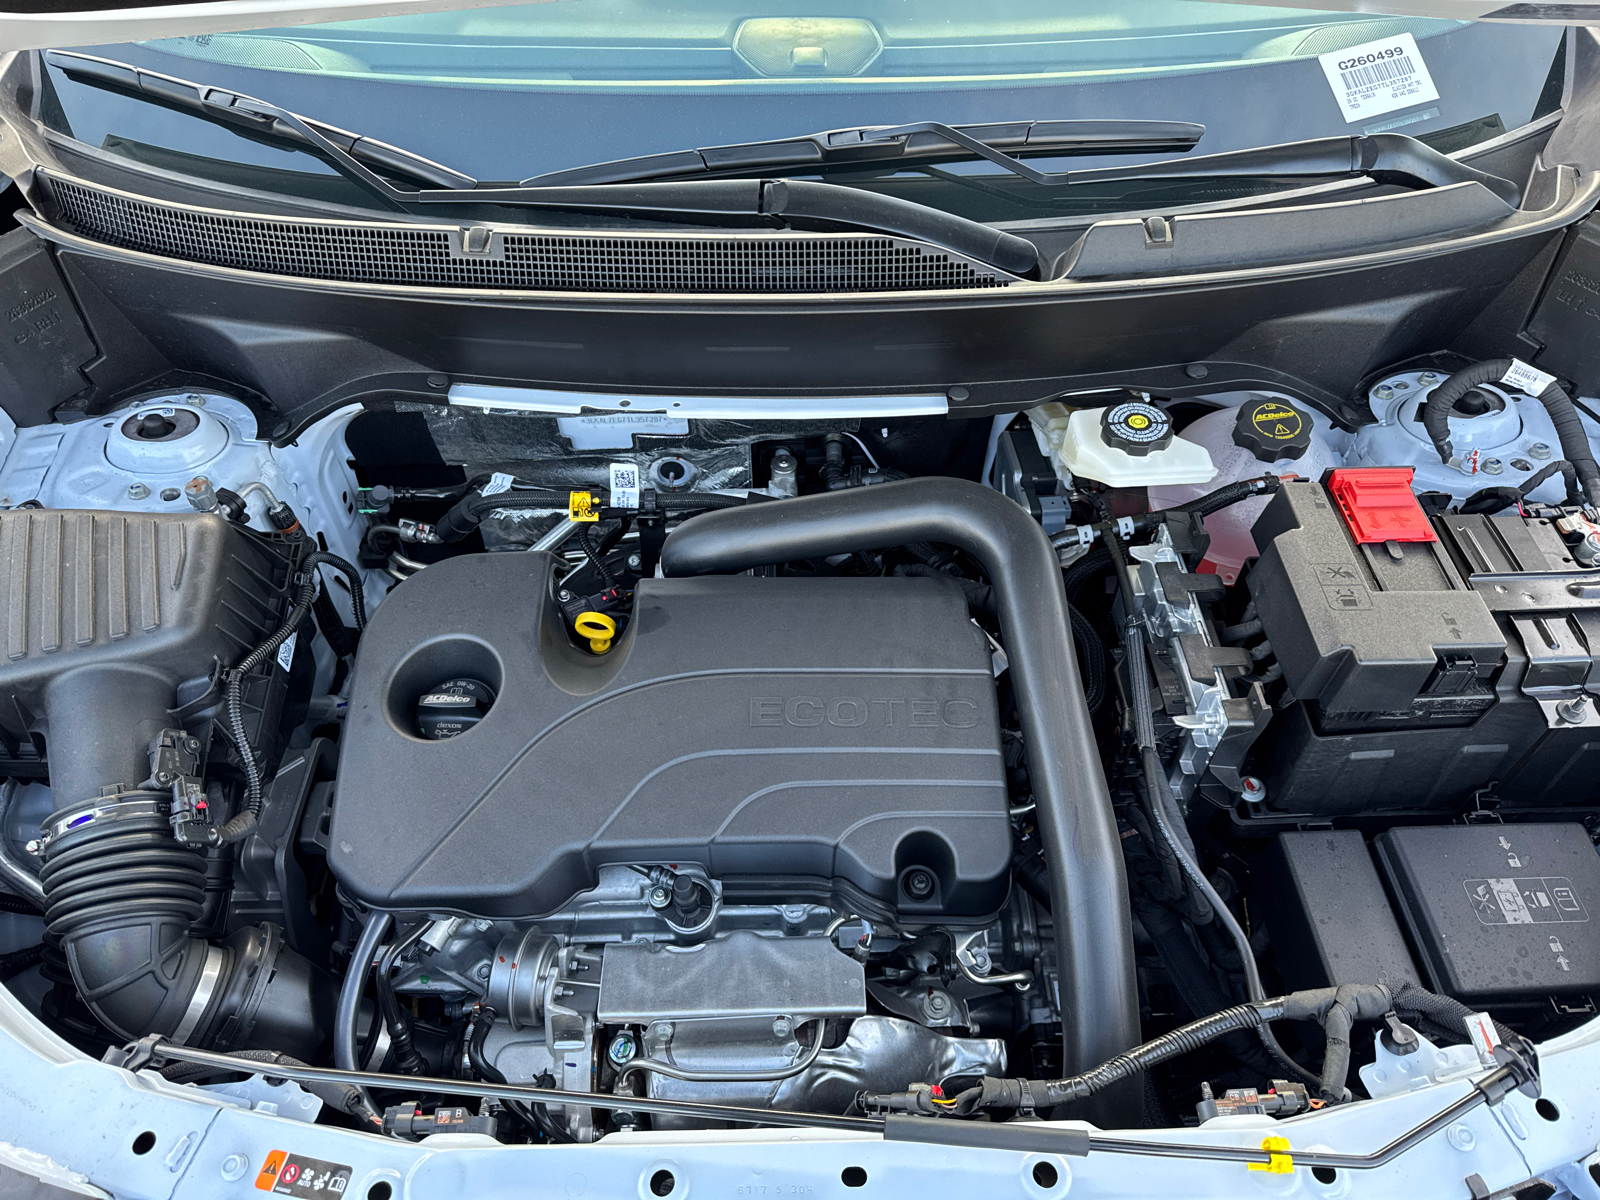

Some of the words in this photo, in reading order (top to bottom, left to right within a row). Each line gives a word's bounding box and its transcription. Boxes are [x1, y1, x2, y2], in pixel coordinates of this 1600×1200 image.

[1338, 46, 1404, 71] G260499
[1255, 411, 1295, 421] ACDelco
[441, 681, 454, 690] SAE
[456, 680, 476, 691] 0W-20
[423, 694, 471, 704] ACDelco
[750, 695, 978, 729] ECOTEC
[436, 721, 463, 729] dexos
[455, 1108, 463, 1118] B
[296, 1179, 312, 1188] AUTO
